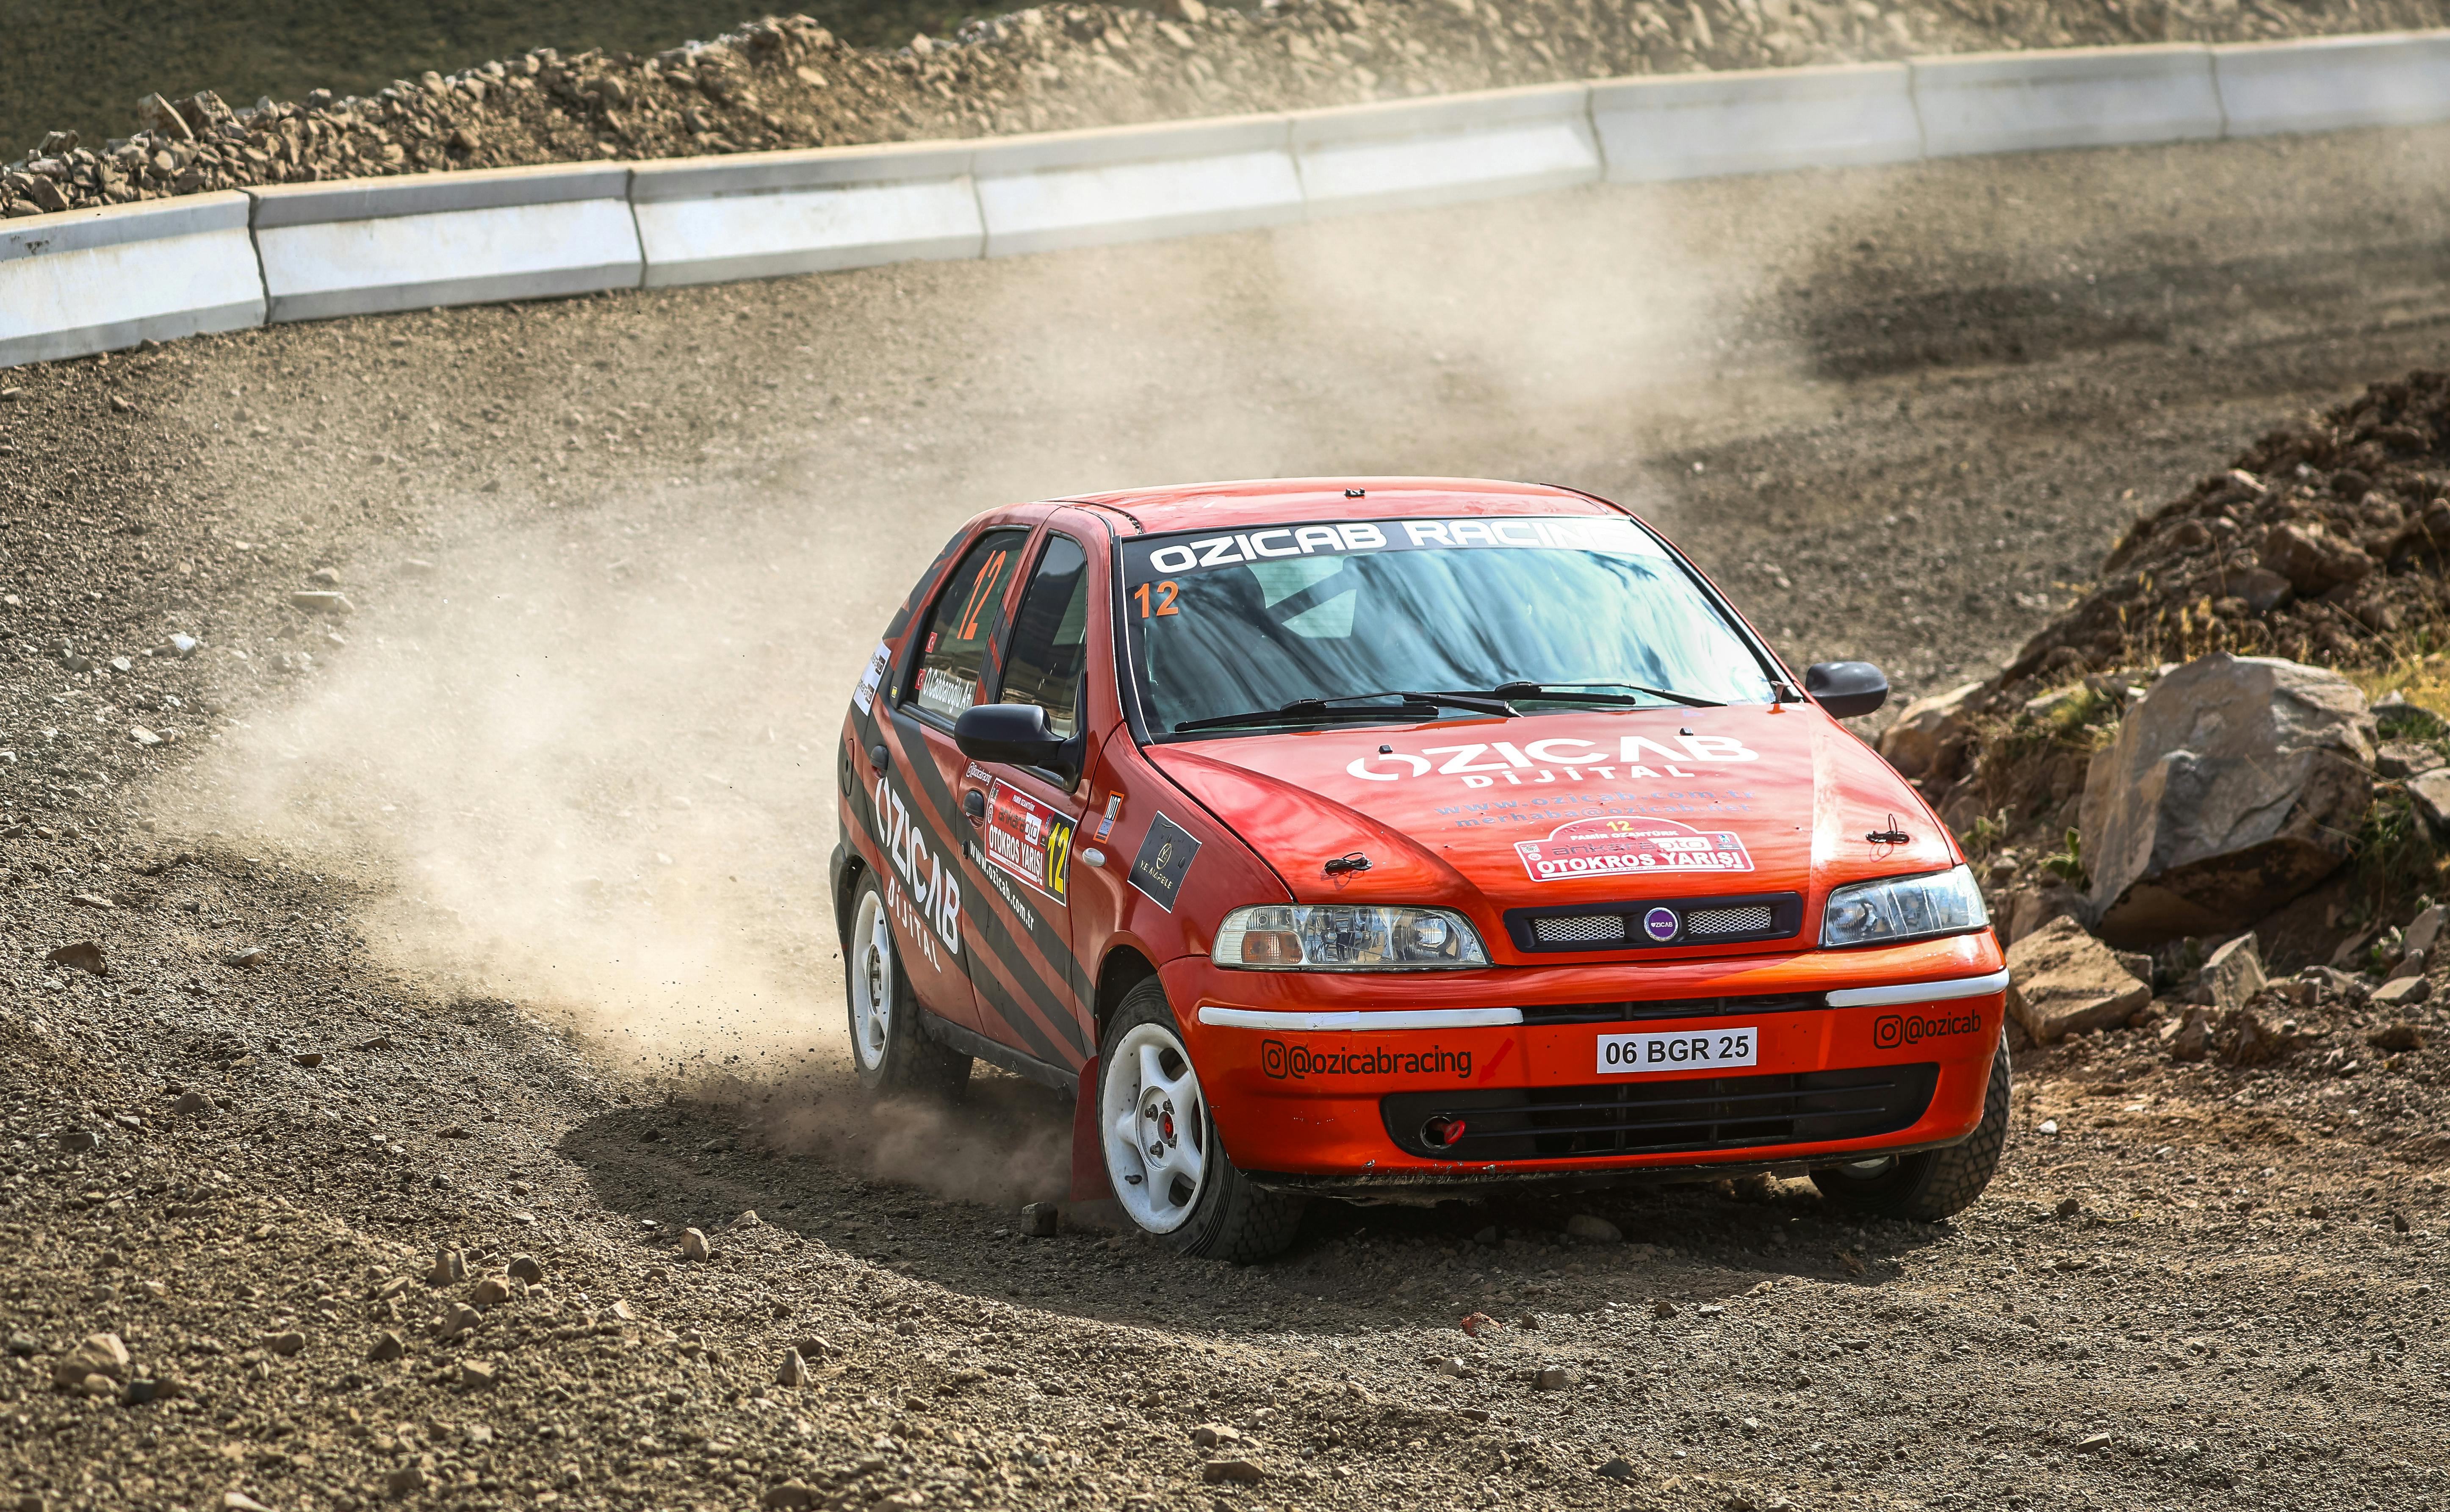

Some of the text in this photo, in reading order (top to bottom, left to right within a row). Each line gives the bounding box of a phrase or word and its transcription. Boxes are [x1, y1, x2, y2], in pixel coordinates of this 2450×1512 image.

[1149, 520, 1628, 573] OZICAB RACIN
[957, 550, 1006, 640] 12
[1134, 581, 1179, 618] 12
[1346, 735, 1760, 781] OZICAB
[1105, 795, 1121, 820] NOT
[1434, 789, 1756, 816] www.ozicab.com.tr
[1455, 802, 1754, 828] merhaba@ozicab.net
[1570, 830, 1680, 841] PAMİR OZANTÜRK
[1606, 820, 1634, 831] 12
[875, 776, 960, 954] OZICAB
[989, 824, 1043, 883] OTOKROS YARIŞI
[1047, 822, 1069, 894] 12
[1536, 852, 1743, 874] OTOKROS YARIŞI
[970, 840, 1034, 931] www.ozicab.com.tr
[1149, 867, 1173, 889] MARBLE
[1905, 1009, 1981, 1044] @ozicab
[1289, 1045, 1472, 1079] @ozicabracing
[1606, 1035, 1750, 1065] 06 BGR 25
